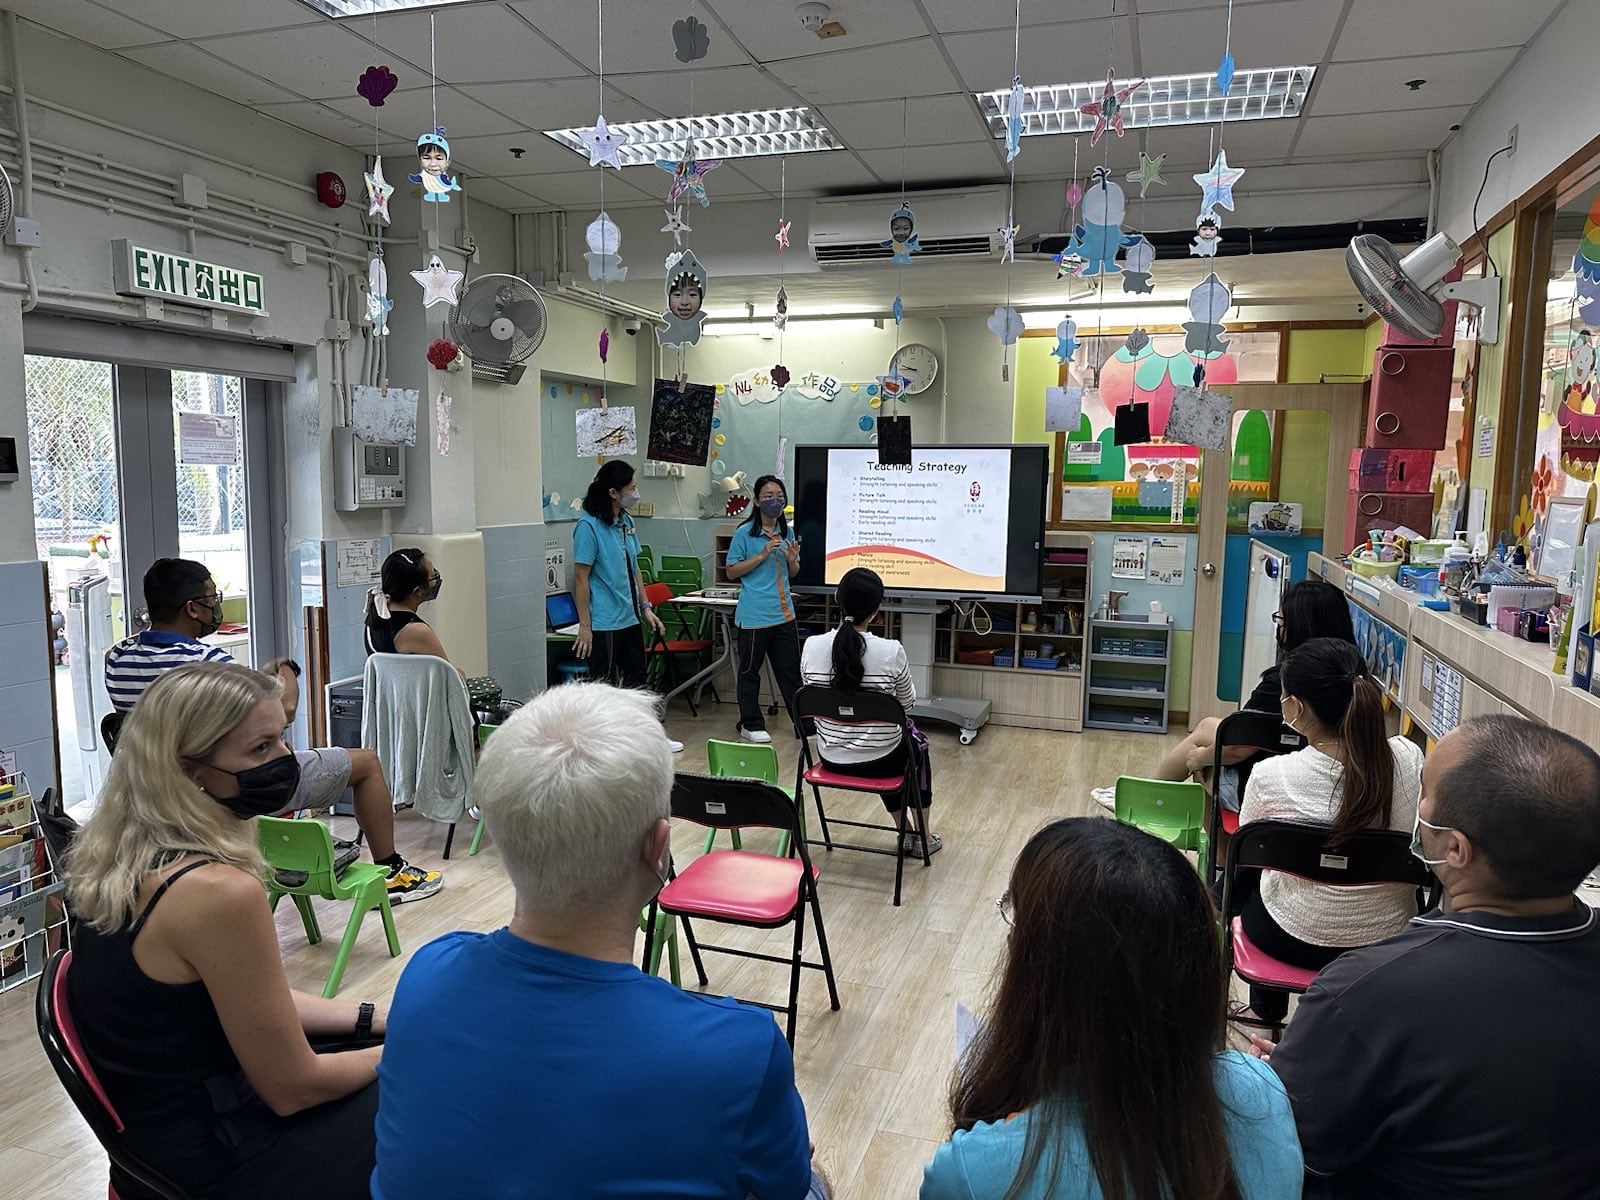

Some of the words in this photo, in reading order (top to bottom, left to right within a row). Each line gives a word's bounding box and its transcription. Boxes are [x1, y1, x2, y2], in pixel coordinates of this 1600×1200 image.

[135, 249, 190, 296] EXIT
[218, 269, 262, 310] 出口
[735, 380, 752, 395] N4
[801, 372, 836, 396] 作品
[867, 461, 913, 473] Teaching
[918, 462, 967, 474] Strategy
[20, 896, 43, 908] Panda
